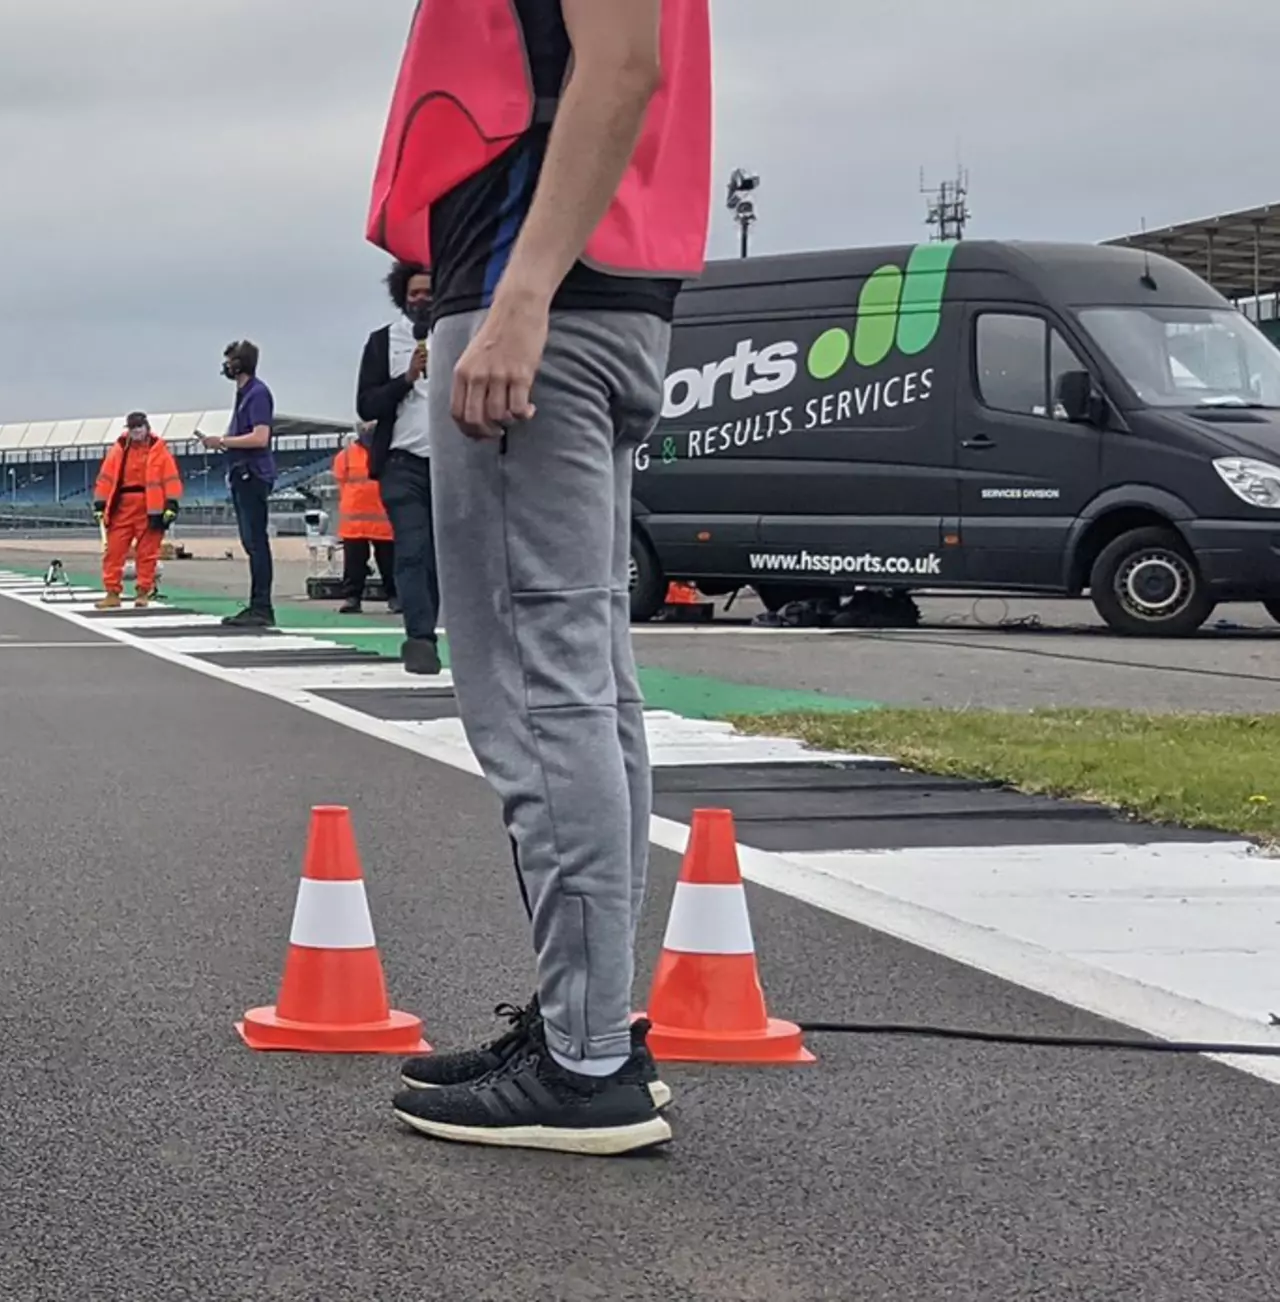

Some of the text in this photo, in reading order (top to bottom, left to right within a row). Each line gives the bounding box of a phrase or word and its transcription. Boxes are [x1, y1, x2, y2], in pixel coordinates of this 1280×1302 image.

[660, 339, 798, 418] orts
[688, 407, 793, 457] RESULTS
[805, 368, 934, 429] SERVICES
[750, 551, 940, 574] www.hssports.co.uk
